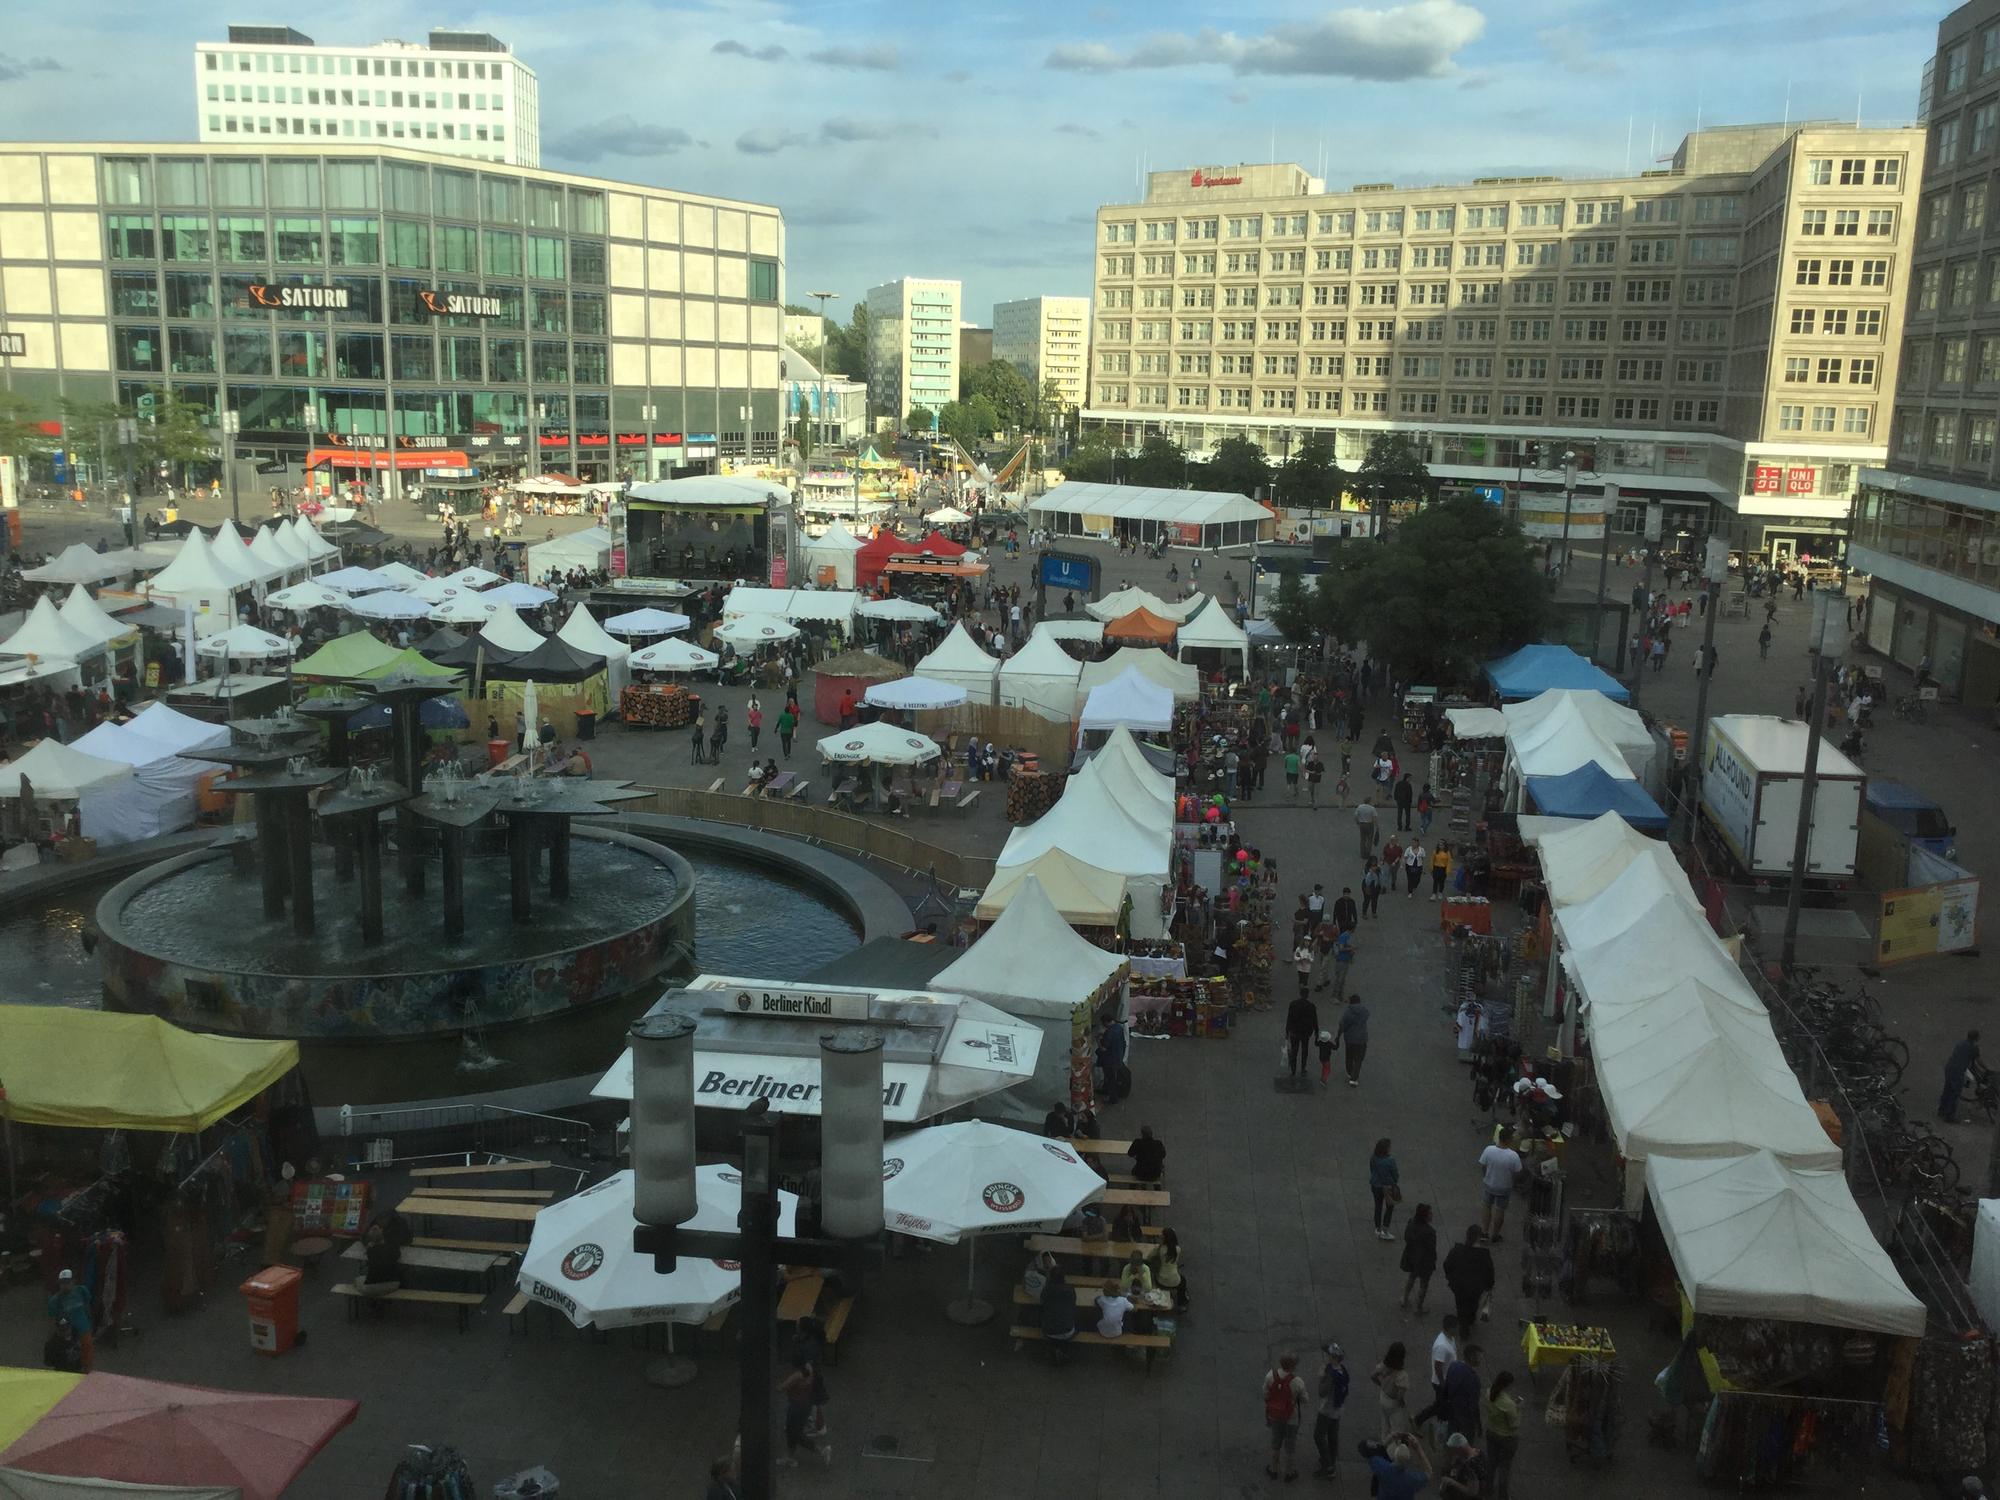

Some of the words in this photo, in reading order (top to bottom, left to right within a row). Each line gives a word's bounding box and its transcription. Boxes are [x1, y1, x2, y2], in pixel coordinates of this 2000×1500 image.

[281, 287, 348, 308] SATURN
[448, 295, 500, 315] SATURN
[414, 436, 447, 448] SATURN
[1791, 471, 1811, 480] UNI
[1790, 481, 1811, 491] QLO
[1062, 562, 1070, 575] U
[1715, 743, 1750, 800] ALLROUND
[762, 993, 803, 1014] Berliner
[804, 995, 832, 1015] Kindl
[697, 1070, 819, 1101] Berliner
[984, 1183, 1019, 1198] ERDINGER
[980, 1221, 1042, 1232] ERDINGER
[574, 1245, 602, 1265] ERDINGER
[532, 1280, 577, 1318] ERDINGER
